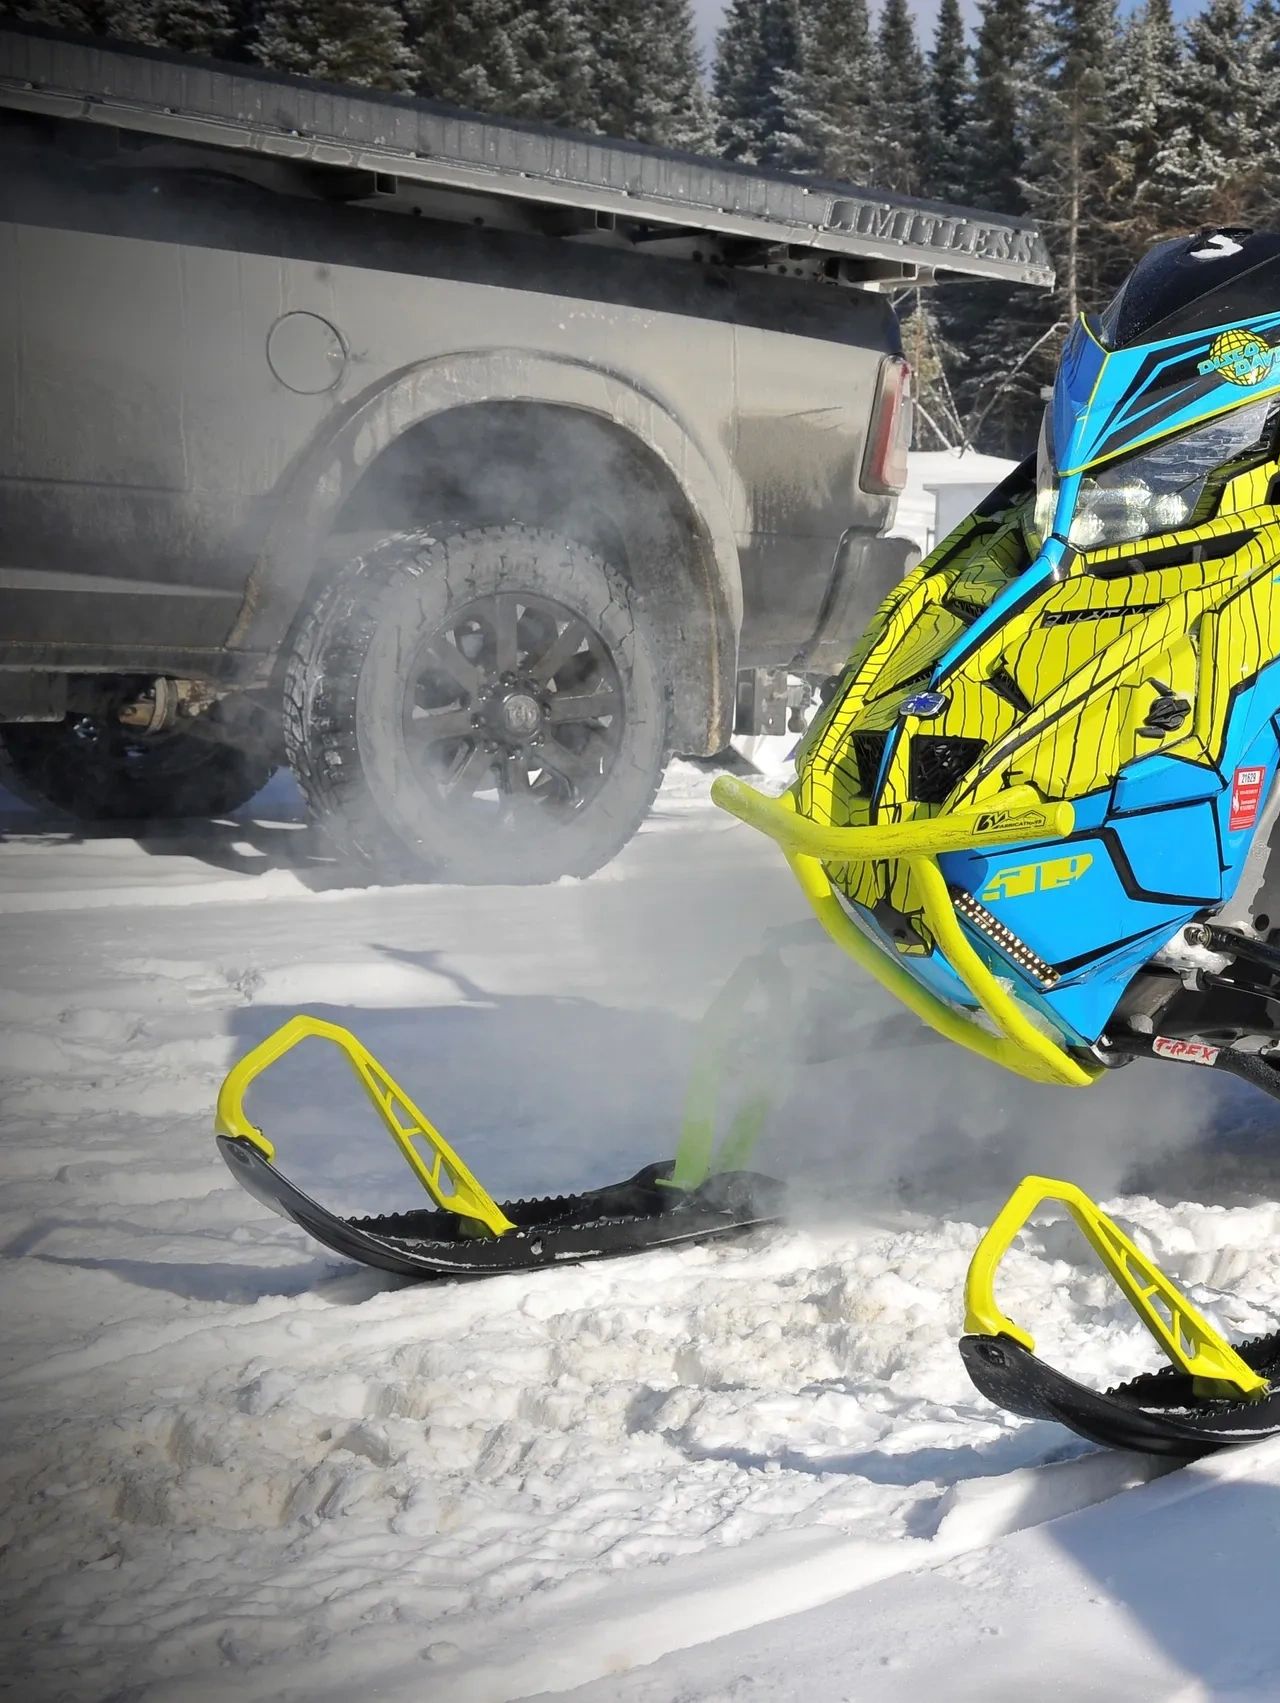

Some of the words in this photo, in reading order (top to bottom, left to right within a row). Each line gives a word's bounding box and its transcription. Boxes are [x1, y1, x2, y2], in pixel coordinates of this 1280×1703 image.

[823, 199, 1034, 264] LIMITLESS
[1197, 341, 1260, 376] DISCO
[1155, 1038, 1220, 1061] T-REX
